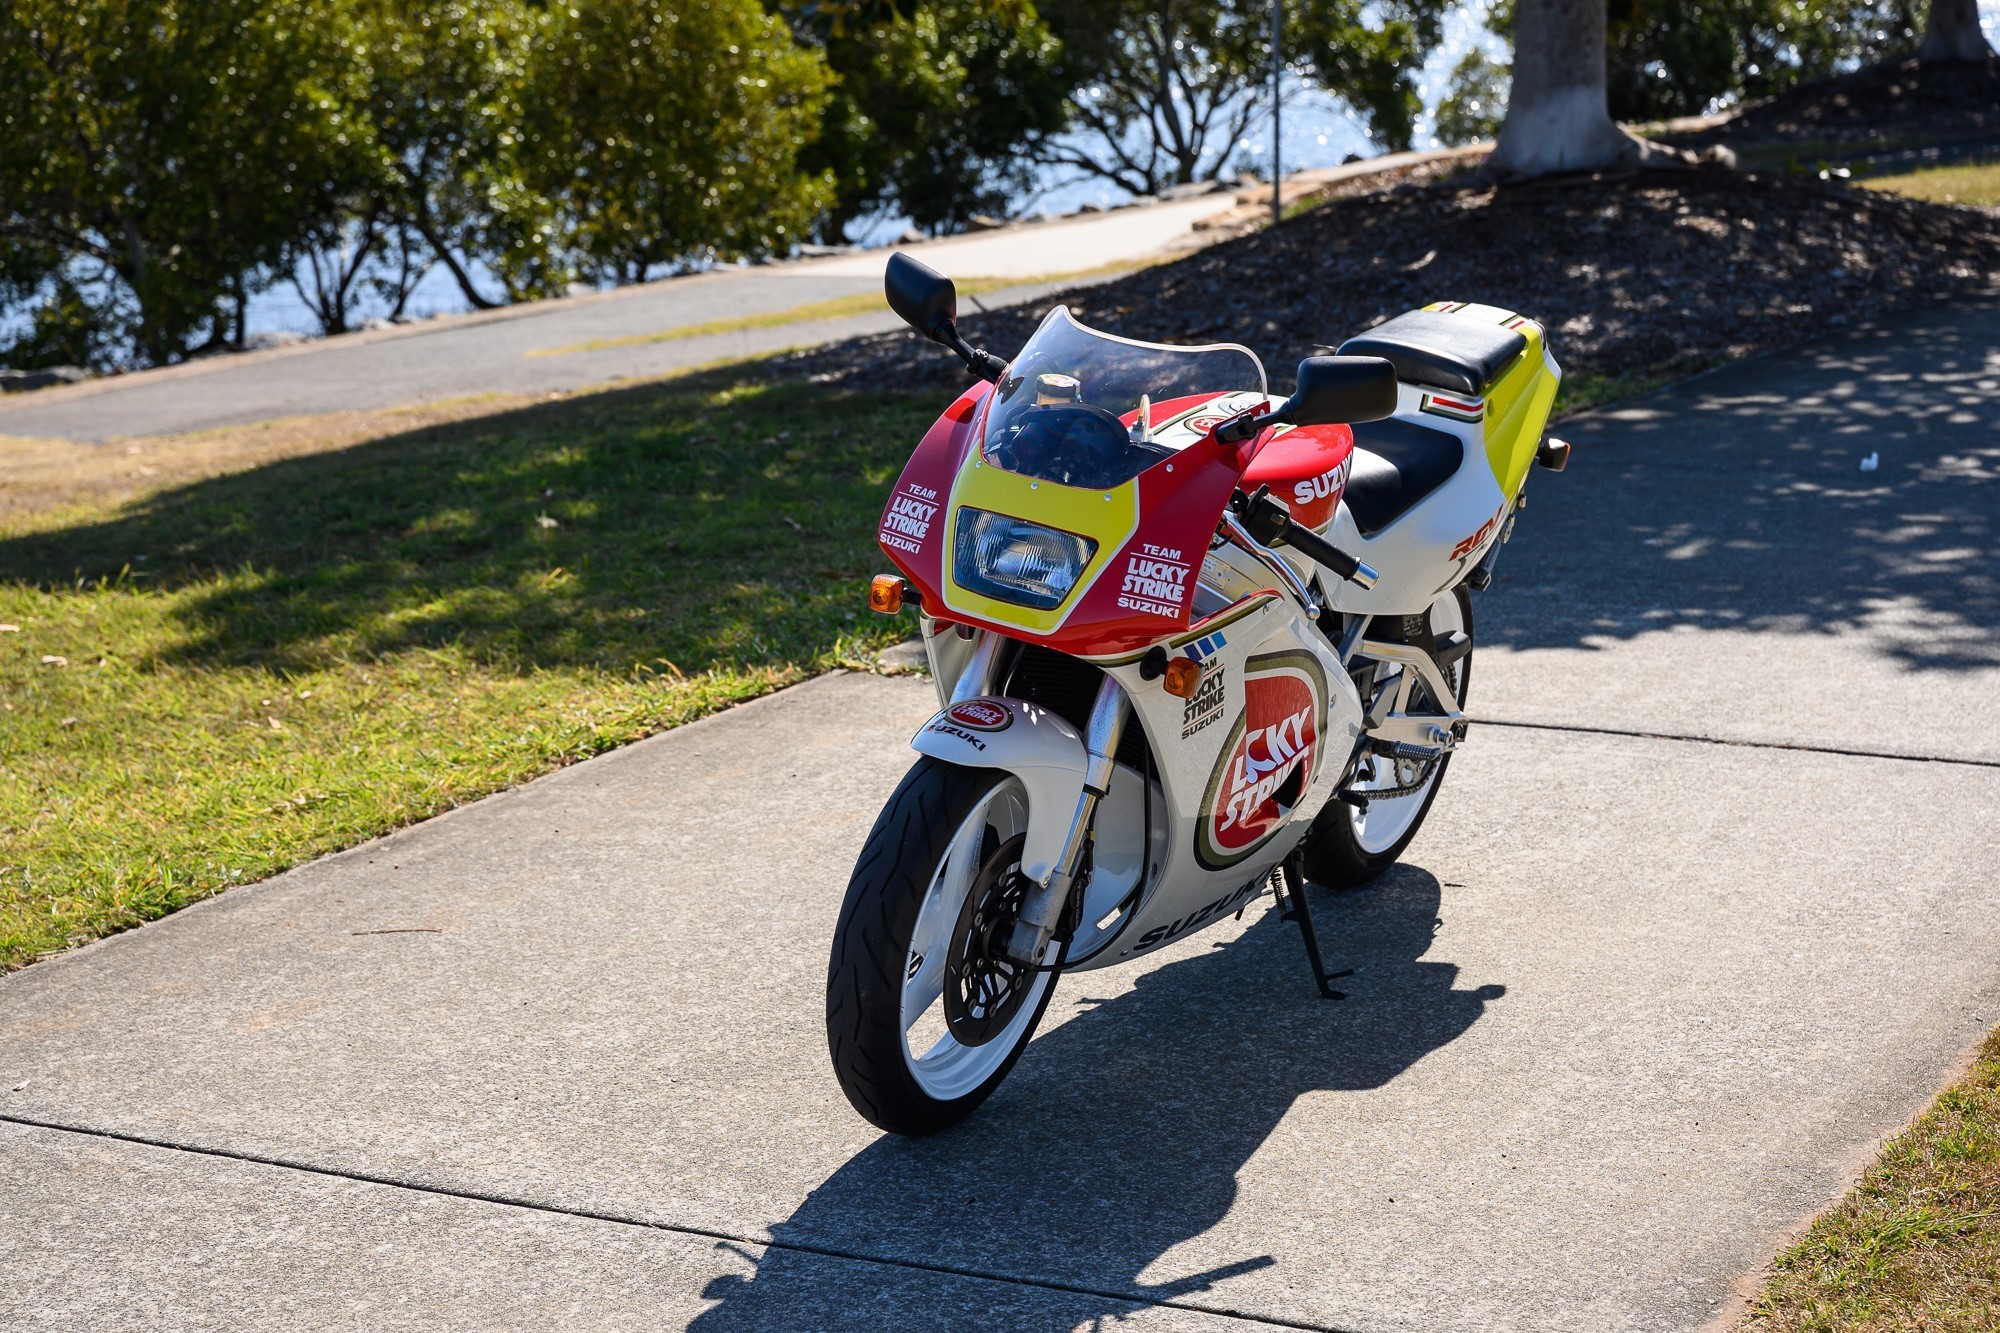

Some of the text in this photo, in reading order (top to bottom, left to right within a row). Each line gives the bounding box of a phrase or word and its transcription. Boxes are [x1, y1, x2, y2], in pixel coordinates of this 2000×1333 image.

[909, 484, 936, 500] TEAM
[892, 496, 937, 523] LUCKY
[884, 511, 930, 539] STRIKE
[880, 533, 920, 554] SUZUKI
[1143, 543, 1181, 560] TEAM
[1127, 557, 1190, 585] LUCKY
[1121, 574, 1186, 603] STRIKE
[1117, 597, 1180, 619] SUZUKI
[952, 708, 996, 724] STRIKE
[1183, 685, 1225, 725] STRIKE
[1181, 708, 1224, 740] SUZUKI
[1132, 861, 1279, 951] SUZUKI
